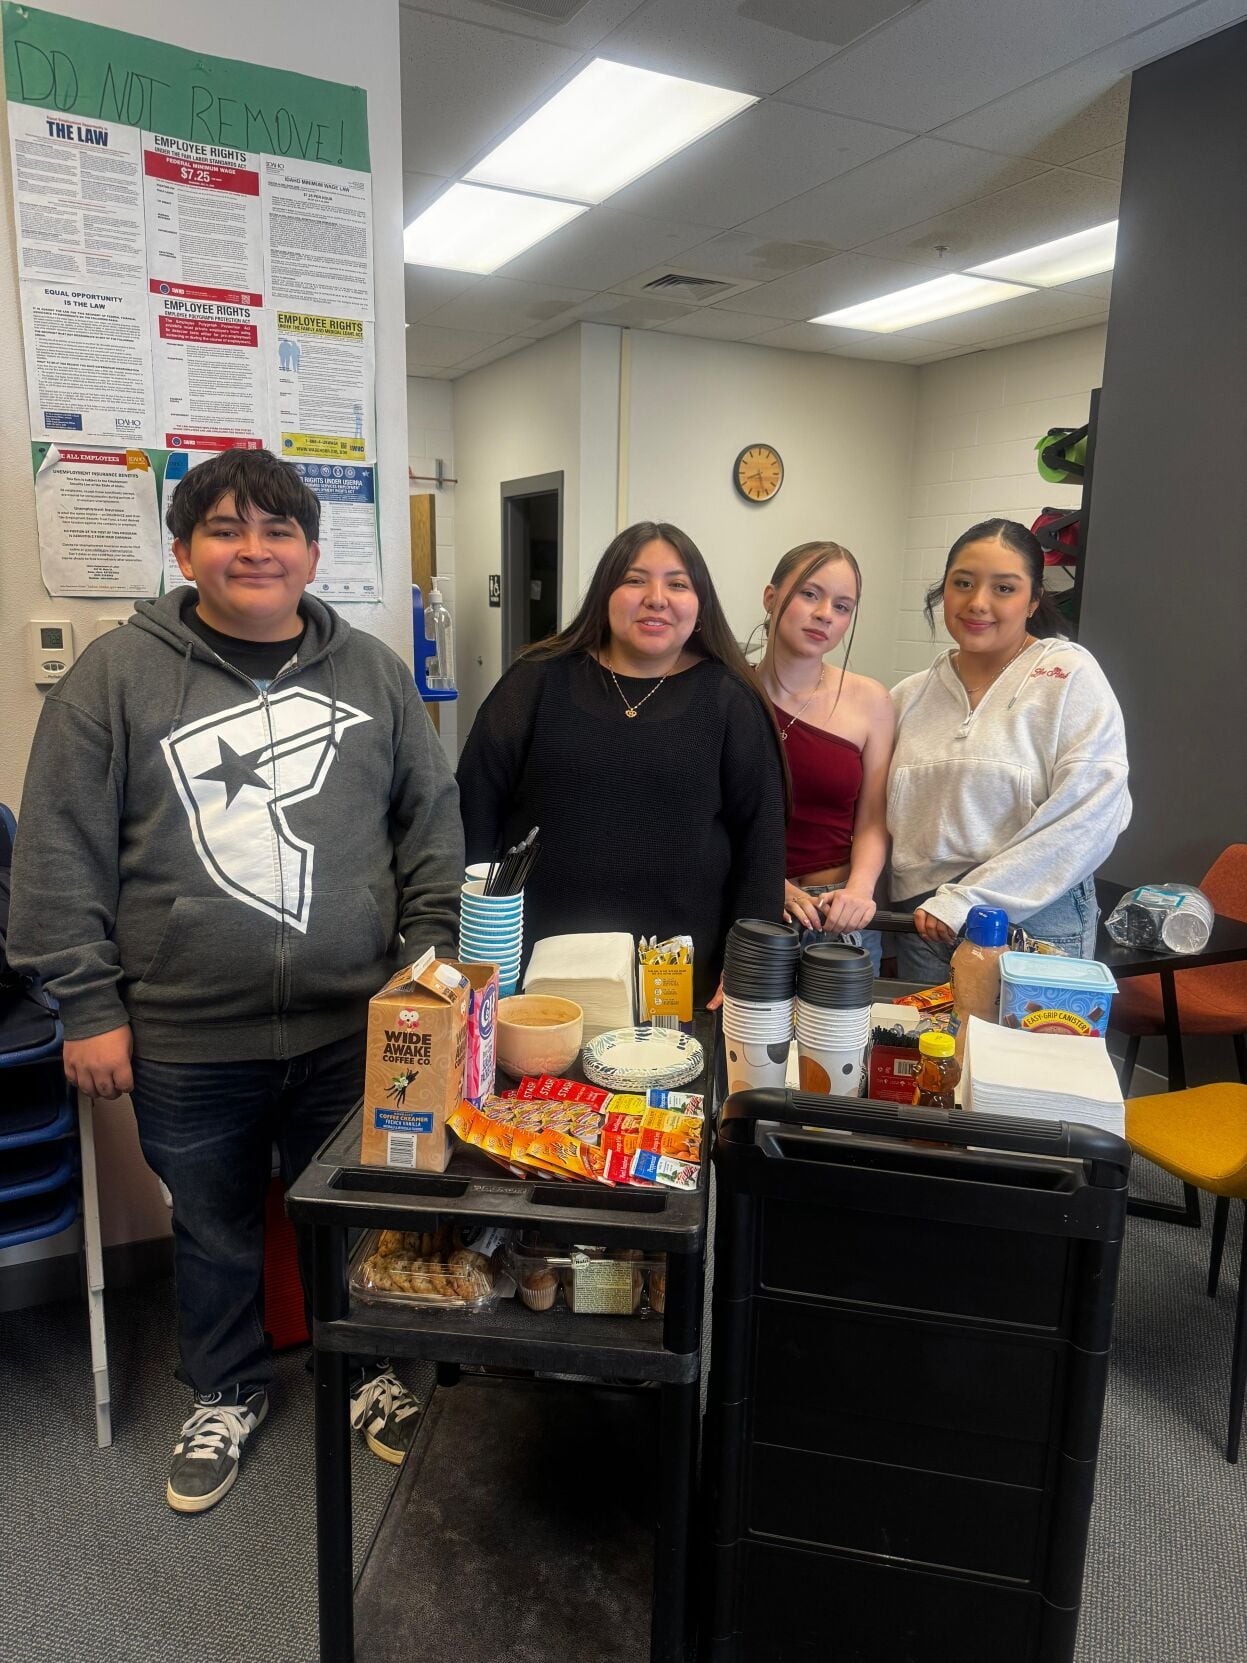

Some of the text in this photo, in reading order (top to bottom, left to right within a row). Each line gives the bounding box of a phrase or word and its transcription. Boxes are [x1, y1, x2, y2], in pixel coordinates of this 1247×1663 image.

[15, 40, 344, 165] DO NOT REMOVE!
[46, 120, 74, 141] THE
[77, 126, 108, 147] LAW
[155, 135, 247, 162] EMPLOYEE RIGHTS
[166, 157, 236, 175] FEDERAL MINIMUM WAGE
[181, 166, 210, 183] $7.25
[44, 288, 123, 303] EQUAL OPPORTUNITY
[73, 300, 88, 308] THE
[90, 302, 106, 310] LAW
[164, 300, 251, 318] EMPLOYEE RIGHTS
[278, 314, 363, 332] EMPLOYEE RIGHTS
[80, 454, 120, 462] EMPLOYEES
[324, 478, 342, 486] UNDER
[1027, 1012, 1087, 1031] EASY-GRIP CANISTER
[384, 1029, 432, 1046] WIDE
[383, 1044, 432, 1058] AWAKE
[382, 1055, 432, 1066] COFFEE CO.
[540, 1078, 555, 1096] STASH
